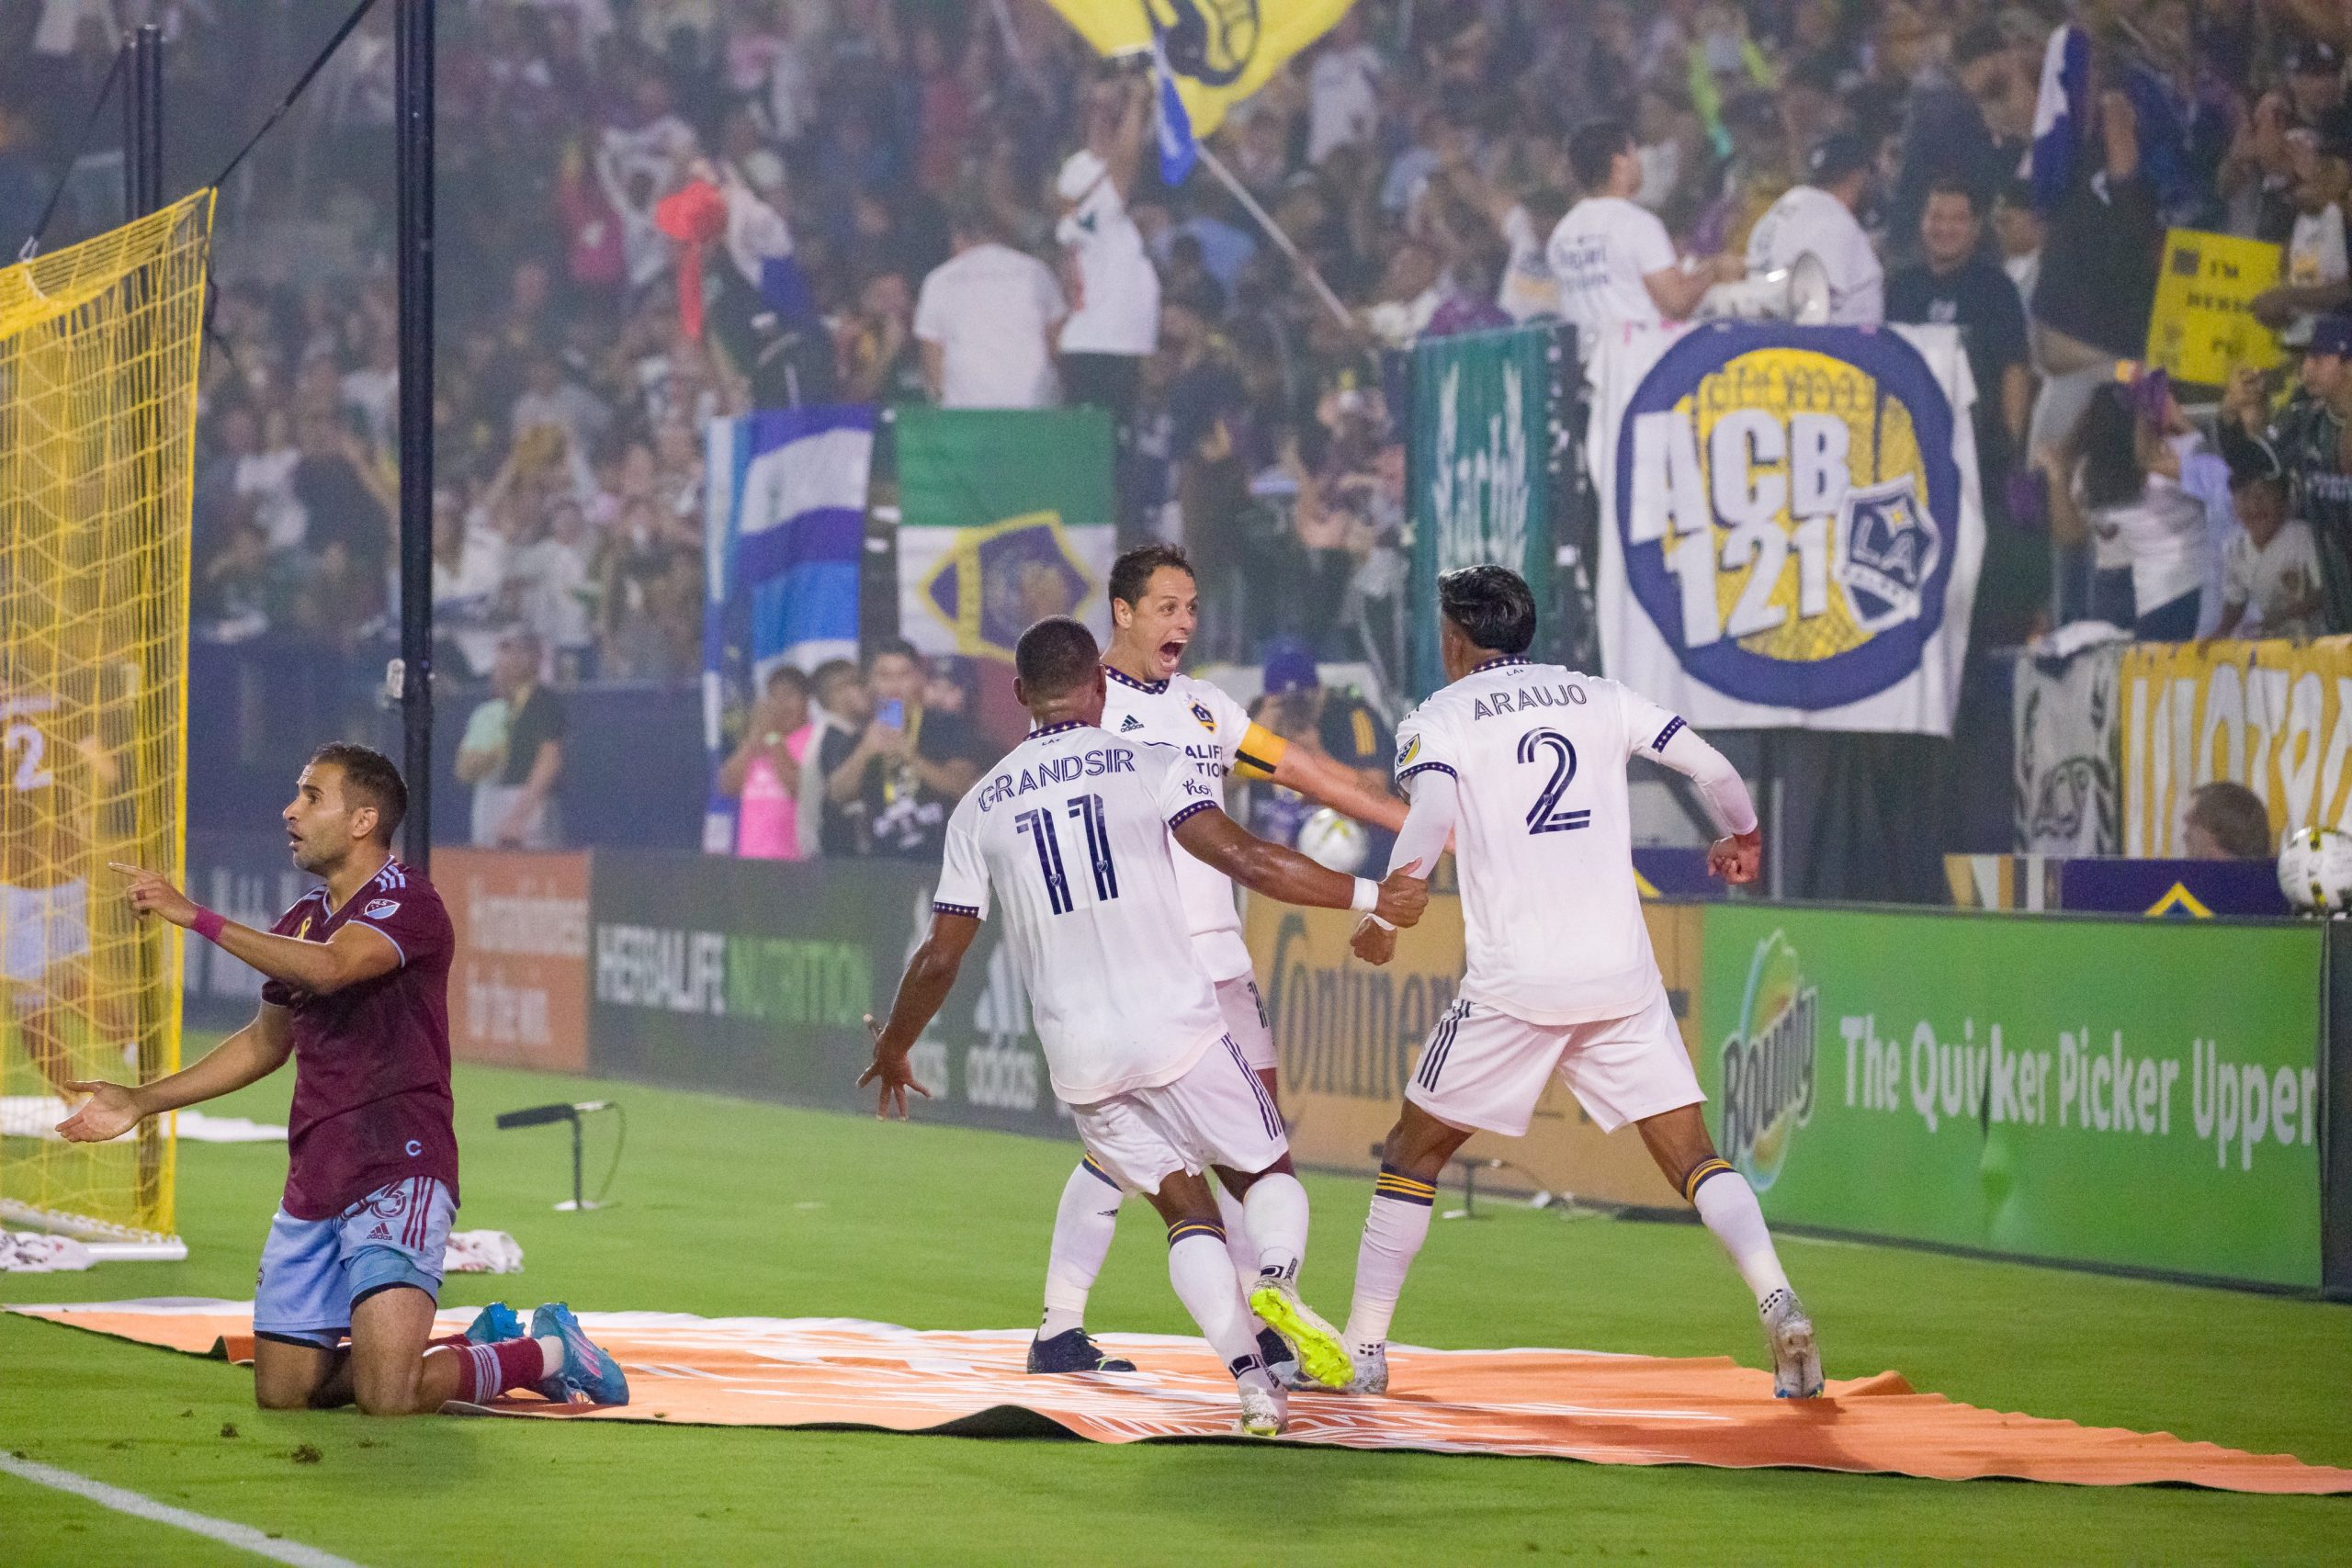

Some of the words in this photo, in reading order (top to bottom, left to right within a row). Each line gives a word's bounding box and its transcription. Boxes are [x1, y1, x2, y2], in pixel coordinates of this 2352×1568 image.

[1629, 408, 1850, 545] ACB
[1665, 518, 1830, 649] 121
[1120, 722, 1146, 733] adidas
[1474, 683, 1588, 721] ARAUJO
[978, 749, 1136, 812] GRANDSIR
[1195, 761, 1222, 778] TIO
[1517, 727, 1591, 835] 2
[1014, 793, 1119, 915] 11
[1722, 990, 1817, 1163] Bounty
[1839, 1013, 1902, 1112] The
[2058, 1025, 2180, 1135] Picker
[2192, 1037, 2318, 1171] Upper
[366, 1233, 393, 1241] adidas
